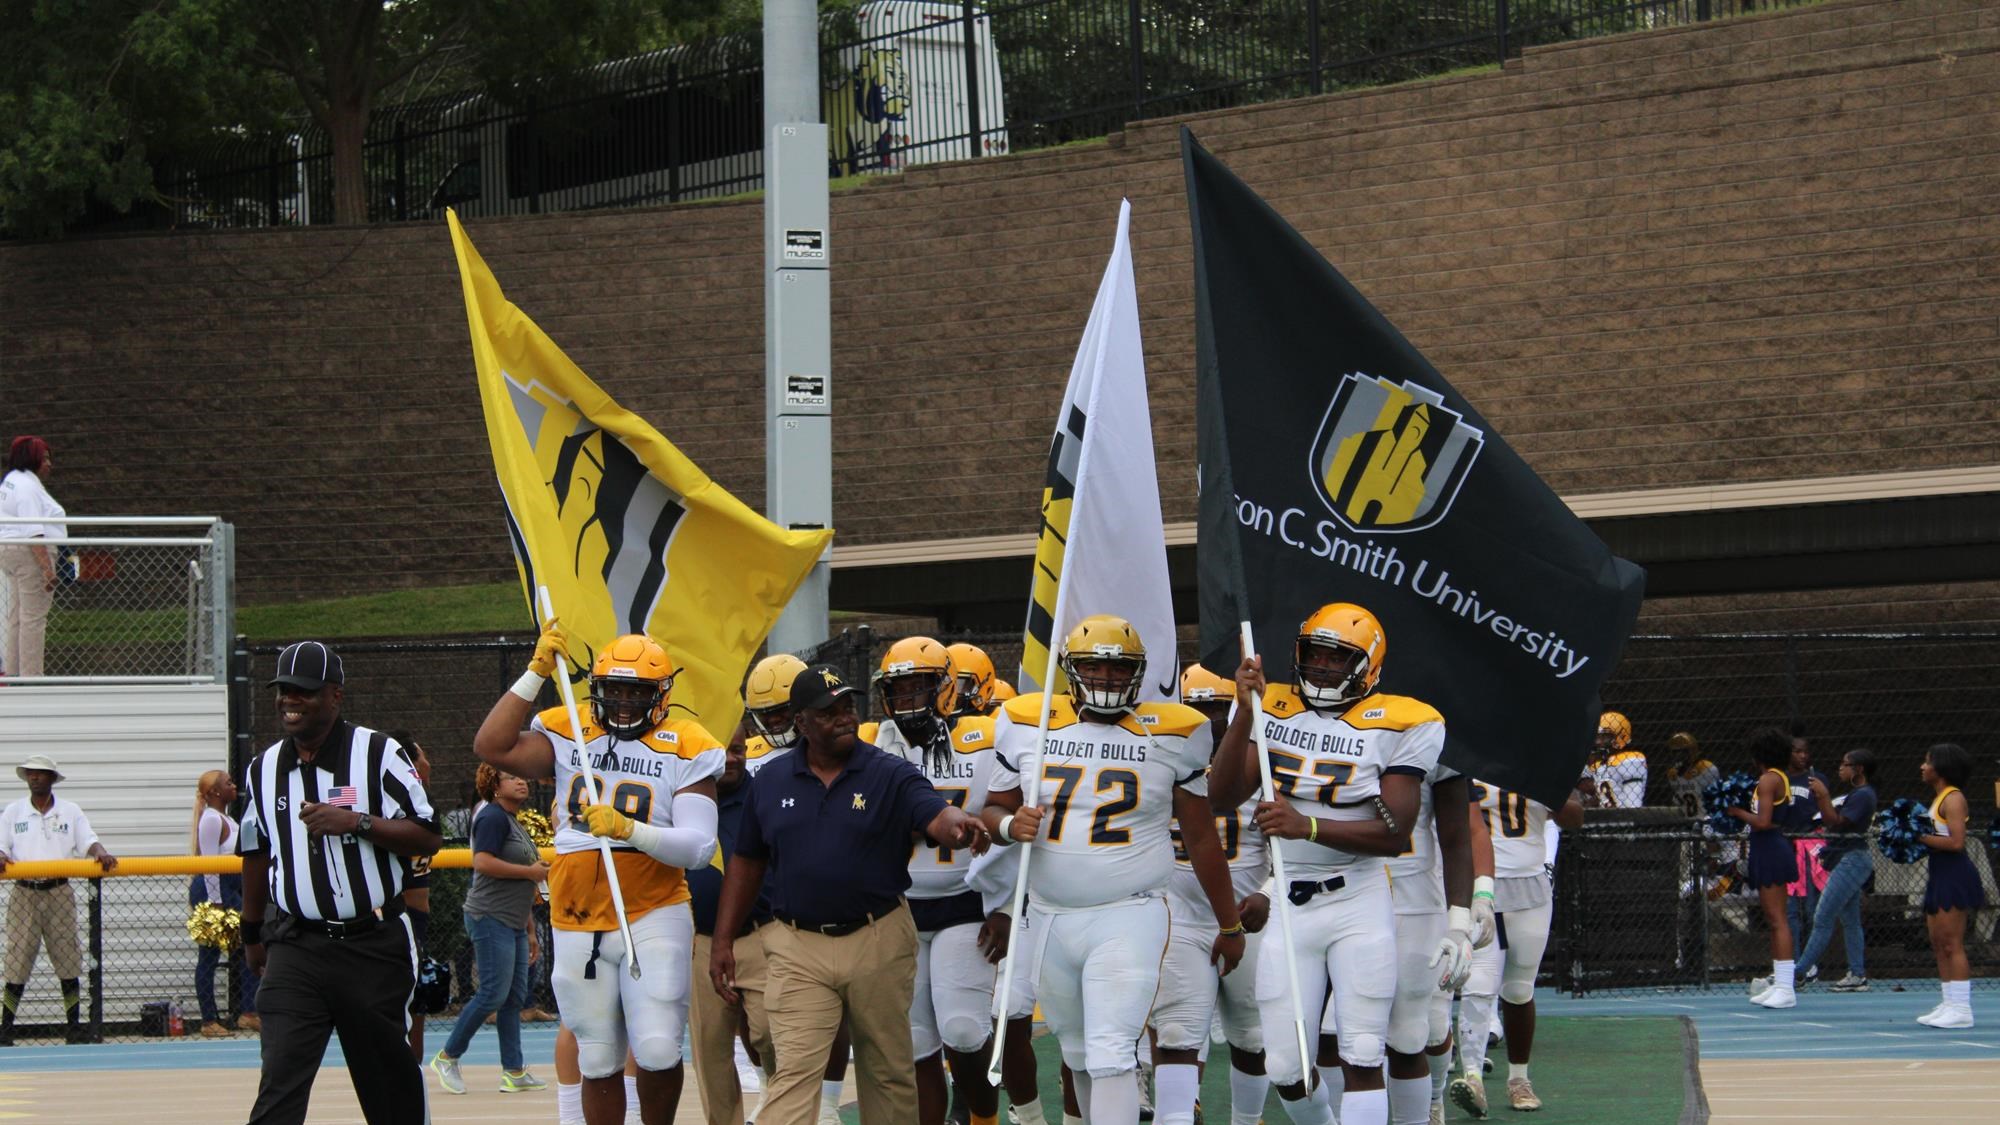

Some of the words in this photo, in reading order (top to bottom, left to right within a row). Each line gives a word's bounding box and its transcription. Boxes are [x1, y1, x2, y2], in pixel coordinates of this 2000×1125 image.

[787, 250, 823, 258] MUSCO
[788, 397, 824, 405] MUSCO
[1279, 507, 1305, 549] C.
[1310, 520, 1406, 587] Smith
[1411, 560, 1590, 679] University
[1265, 720, 1317, 751] GOLDEN
[1322, 733, 1365, 757] BULLS
[1043, 739, 1094, 759] GOLDEN
[1100, 743, 1146, 762] BULLS
[621, 756, 663, 778] BULLS
[277, 796, 288, 811] S
[1042, 761, 1142, 846] 72
